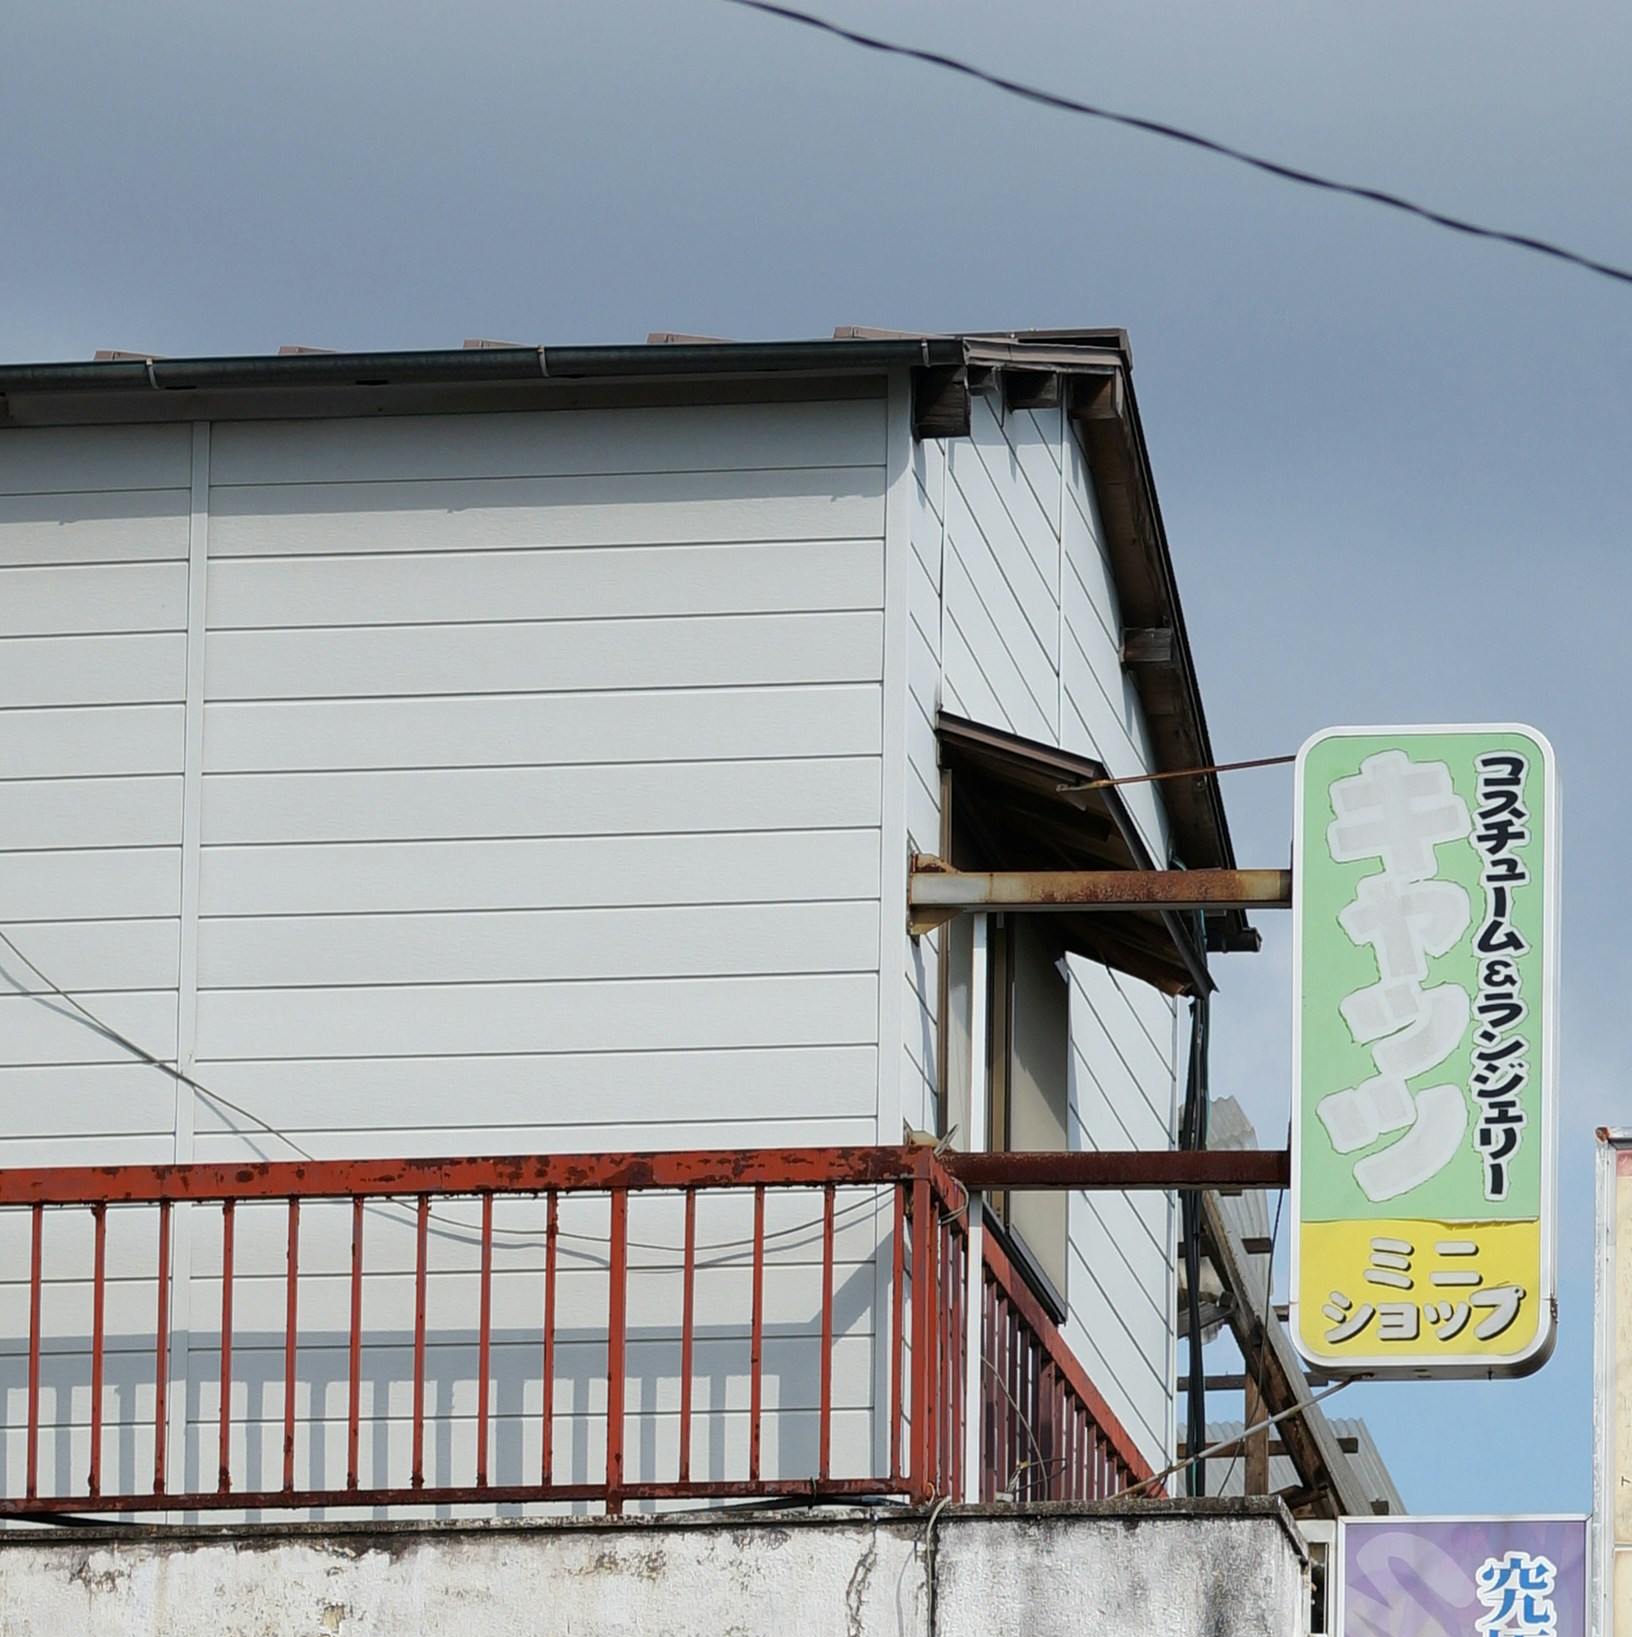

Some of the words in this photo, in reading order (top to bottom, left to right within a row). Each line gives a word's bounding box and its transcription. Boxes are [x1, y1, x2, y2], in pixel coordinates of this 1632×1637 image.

[1364, 1238, 1482, 1290] ミニ
[1322, 1284, 1525, 1344] ショップ
